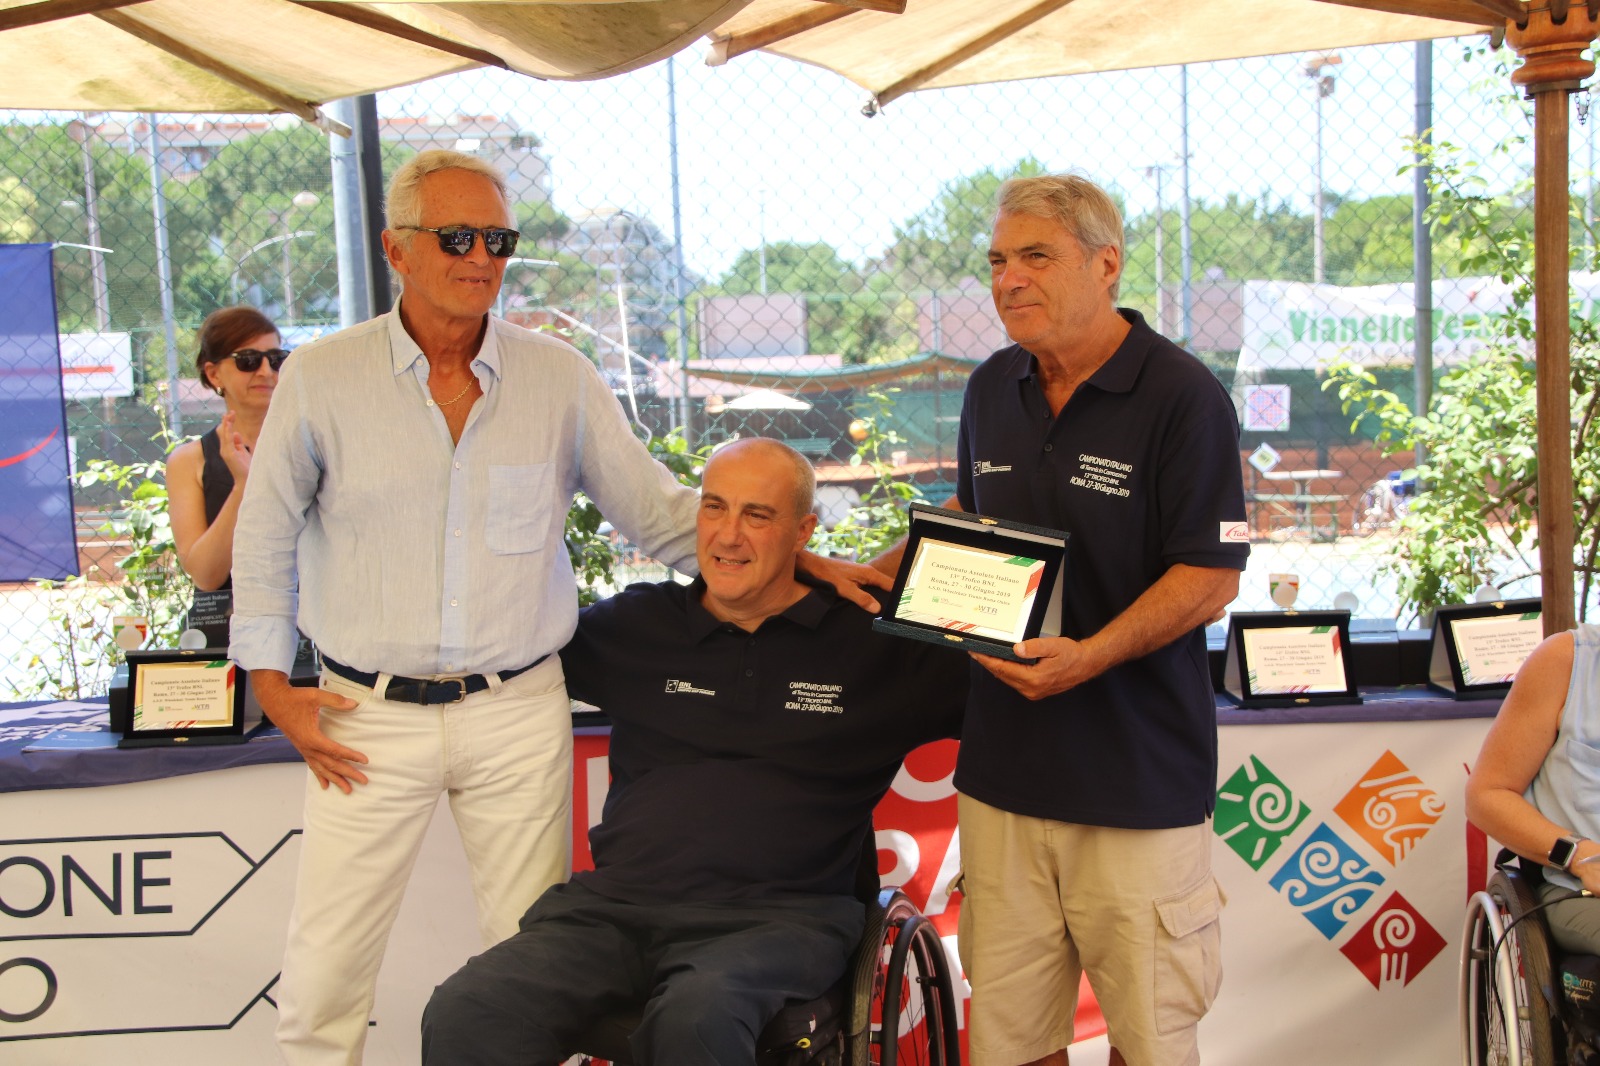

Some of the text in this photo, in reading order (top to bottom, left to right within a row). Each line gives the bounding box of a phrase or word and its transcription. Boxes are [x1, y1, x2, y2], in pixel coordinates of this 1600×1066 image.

[1078, 454, 1110, 467] CAMPIONATO
[1070, 476, 1086, 486] ROMA
[1117, 488, 1130, 498] 2019
[931, 561, 1020, 584] Campionato Assoluto Italiano
[962, 576, 981, 584] Trofeo
[972, 585, 995, 595] Giugno
[789, 682, 821, 691] CAMPIONATO
[784, 701, 800, 710] ROMA
